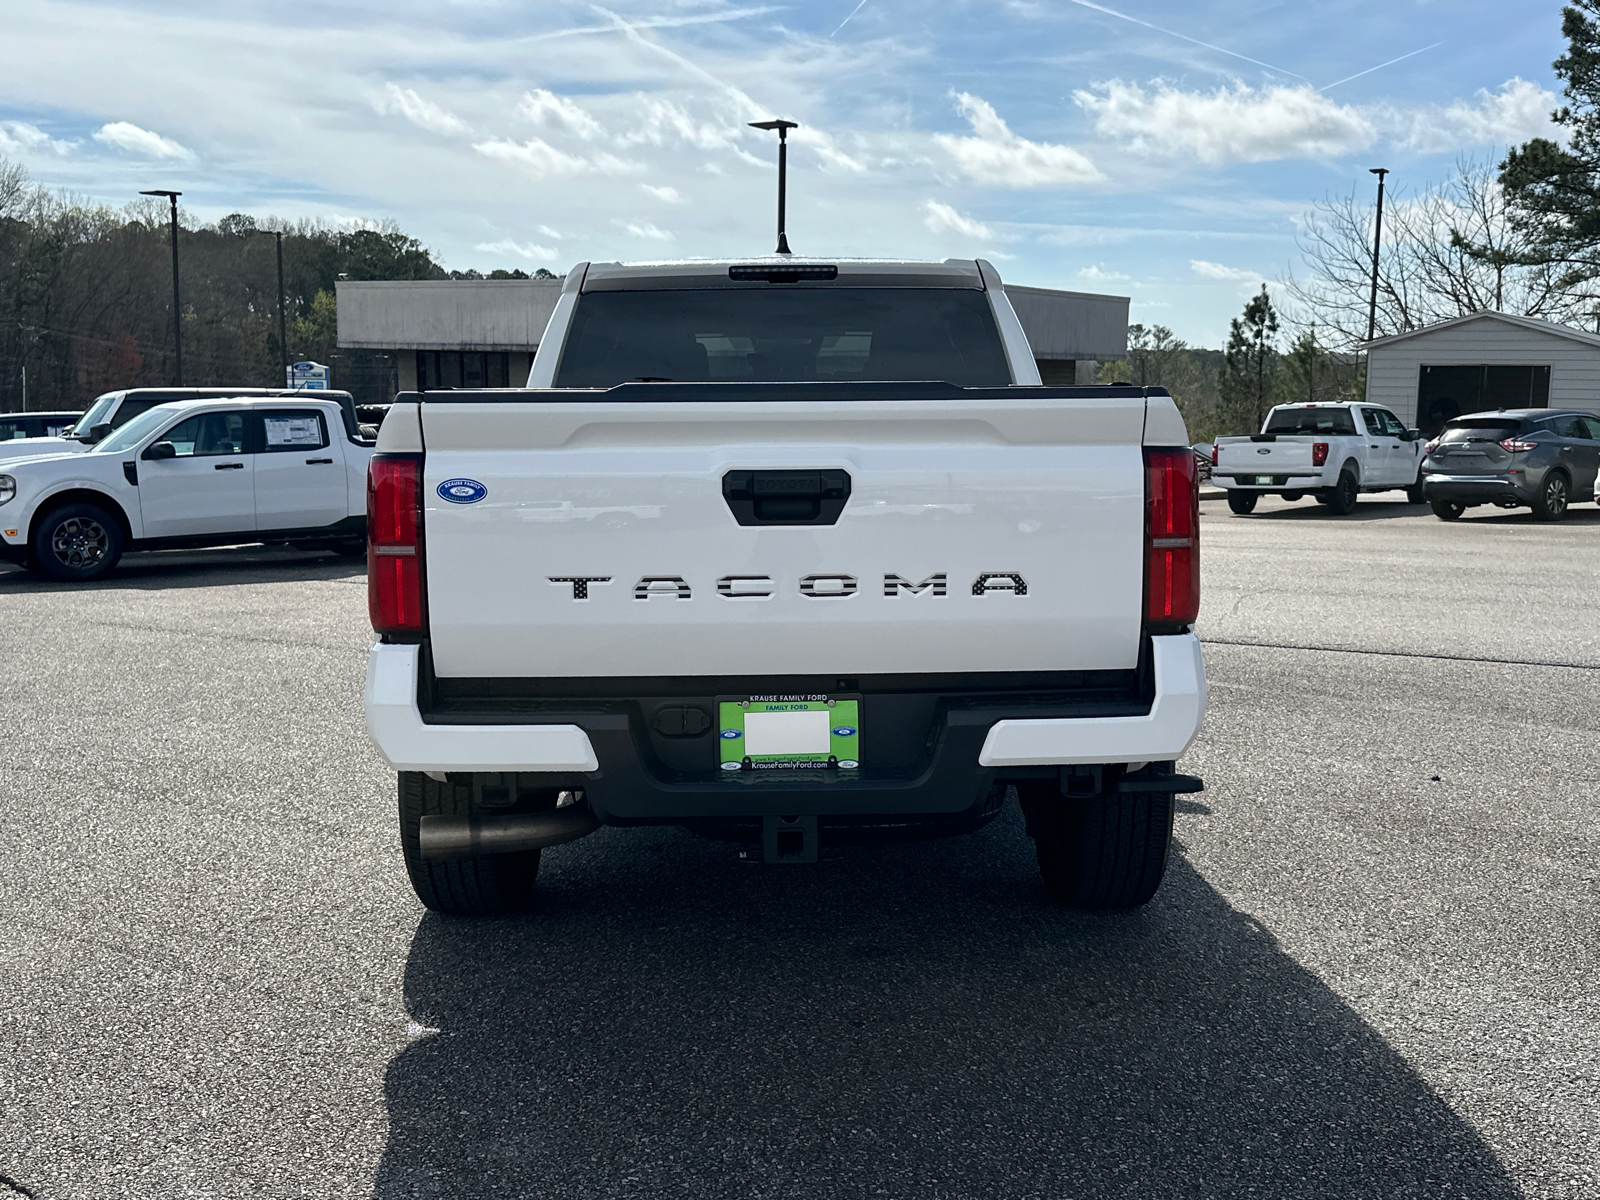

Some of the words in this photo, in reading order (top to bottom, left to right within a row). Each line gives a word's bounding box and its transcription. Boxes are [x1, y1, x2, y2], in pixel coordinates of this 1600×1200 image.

[757, 479, 817, 490] TOYOTA
[546, 572, 1030, 601] TACOMA
[751, 761, 828, 770] KrauseFamilyFord.com
